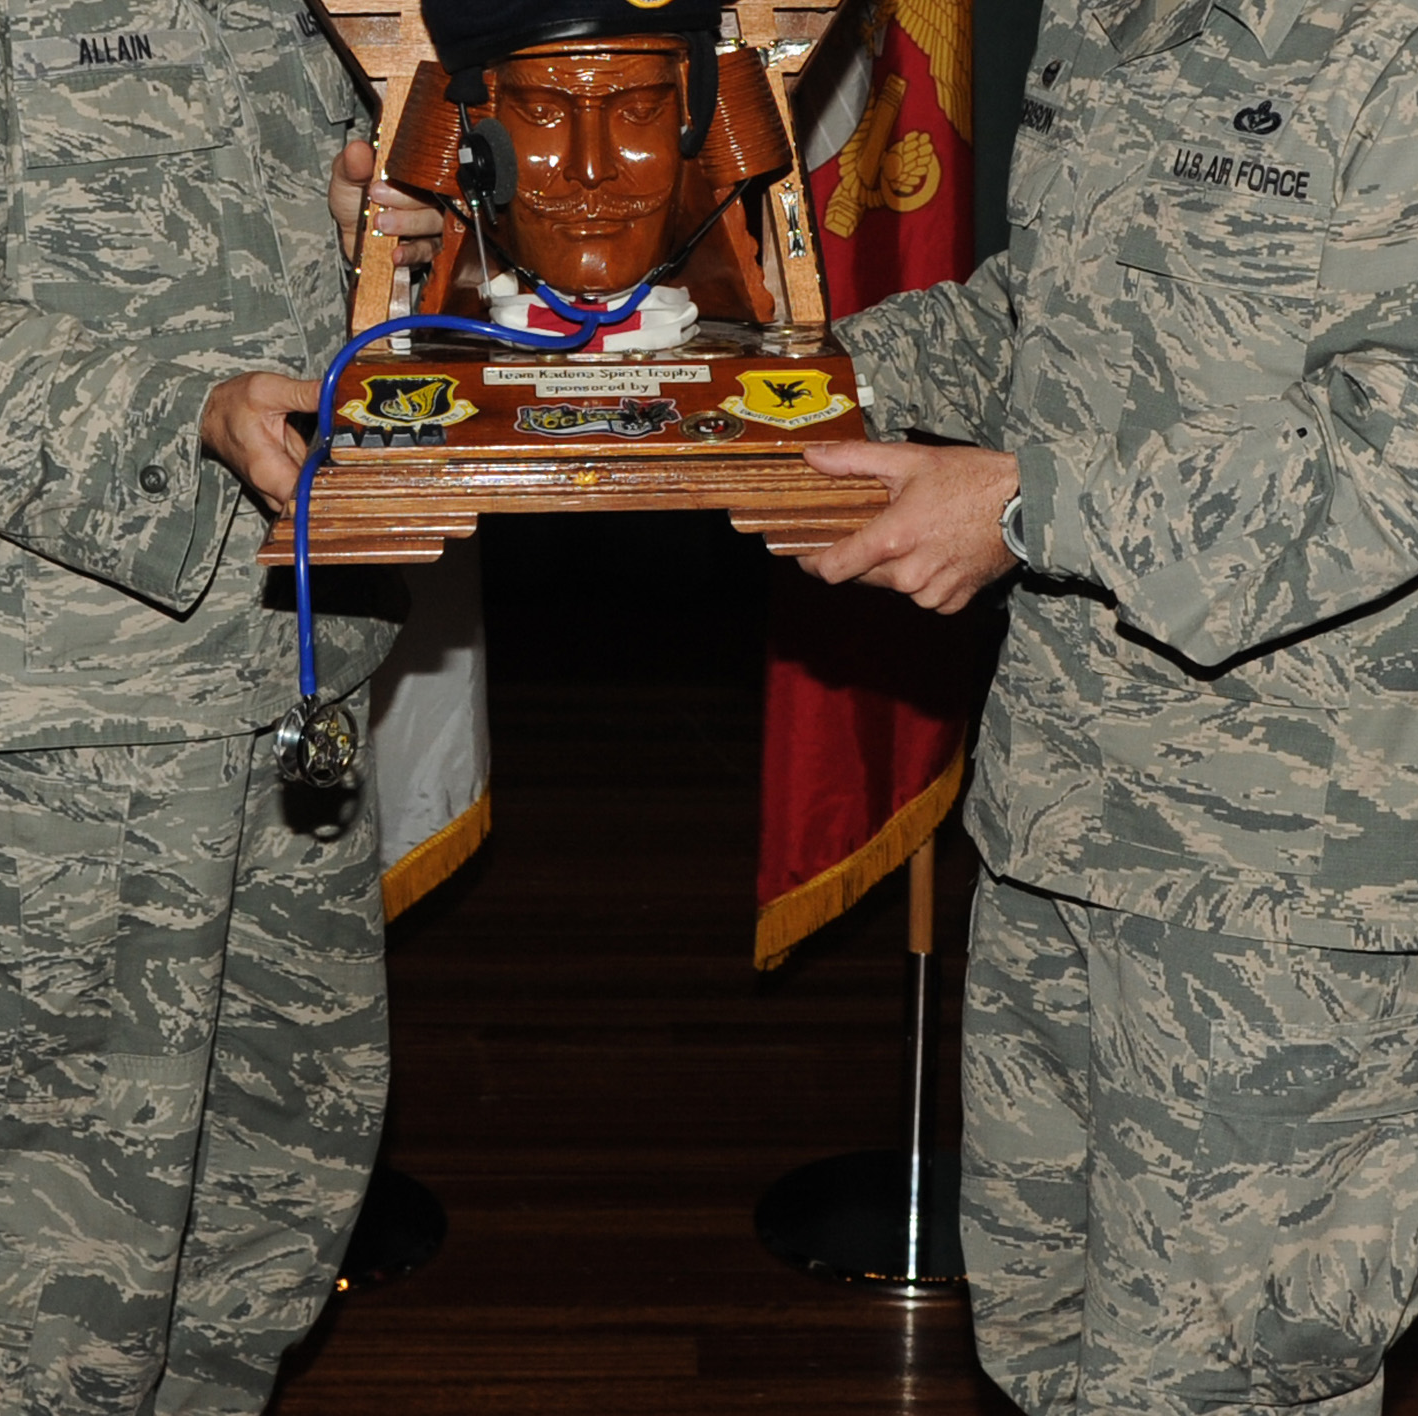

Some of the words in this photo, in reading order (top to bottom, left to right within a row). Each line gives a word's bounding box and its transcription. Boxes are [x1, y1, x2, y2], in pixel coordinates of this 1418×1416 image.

[79, 34, 153, 65] ALLAIN
[1203, 155, 1234, 186] AIR
[1234, 160, 1310, 199] FORCE
[538, 369, 595, 379] Kadena
[600, 369, 642, 381] Spirit
[545, 383, 626, 394] sponsored
[631, 383, 650, 394] by
